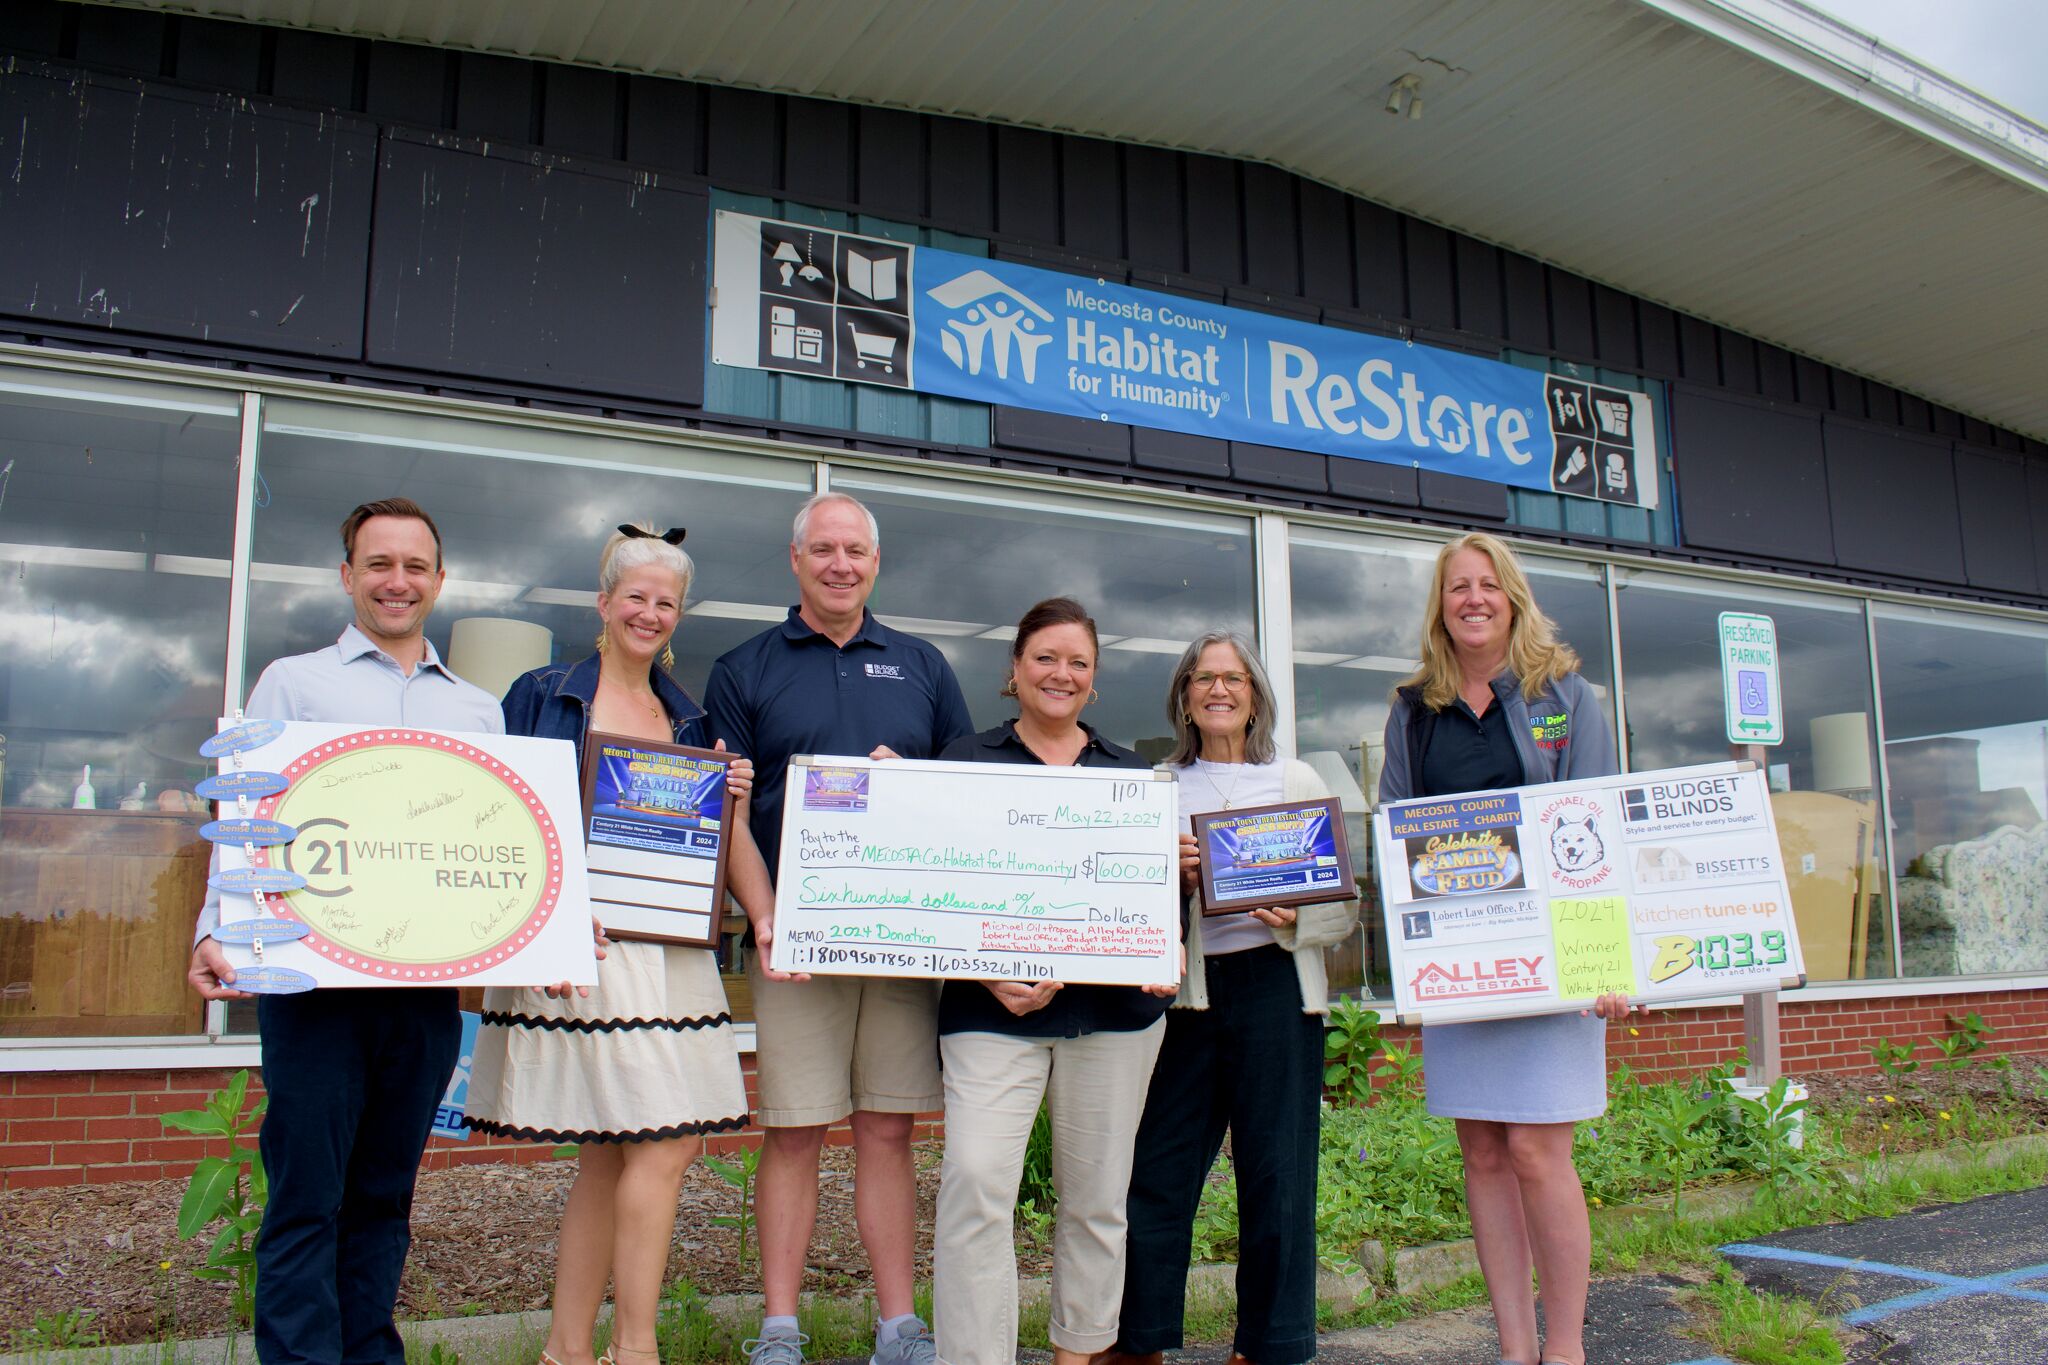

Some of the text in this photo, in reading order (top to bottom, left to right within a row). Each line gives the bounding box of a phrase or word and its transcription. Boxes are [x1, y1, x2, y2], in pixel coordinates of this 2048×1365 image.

[1066, 288, 1227, 339] Mecosta County
[1067, 317, 1220, 386] Habitat
[1068, 367, 1102, 394] for
[1725, 625, 1772, 645] RESERVED
[1730, 647, 1772, 666] PARKING
[1530, 716, 1545, 726] 07.1
[603, 747, 725, 773] MECOSTA COUNTY REAL ESTATE CHARITY
[216, 776, 270, 787] Chuck Ames
[628, 773, 697, 799] FAMILY
[1112, 782, 1146, 803] 1101
[1651, 776, 1739, 801] BUDGET
[1008, 808, 1048, 826] DATE
[1054, 805, 1090, 829] May
[1122, 812, 1161, 826] 2024
[1404, 798, 1506, 820] MECOSTA COUNTY
[1540, 796, 1605, 824] MICHAEL OIL
[1655, 796, 1734, 819] BLINDS
[219, 824, 279, 834] Denise Webb
[1208, 809, 1327, 830] MECOSTA COUNTY REAL ESTATE CHARITY
[1394, 823, 1421, 835] REAL
[1423, 818, 1460, 832] ESTATE
[1474, 811, 1521, 826] CHARITY
[1625, 827, 1645, 835] Style
[1647, 824, 1662, 833] and
[1663, 821, 1692, 831] service
[1692, 819, 1704, 828] for
[1705, 818, 1726, 827] every
[696, 837, 712, 845] 2024
[800, 828, 860, 849] Pay to the
[1425, 829, 1503, 855] Celebrity
[354, 841, 435, 861] WHITE
[443, 843, 527, 864] HOUSE
[1416, 845, 1512, 877] FAMILY
[800, 845, 839, 861] Order
[846, 845, 862, 859] of
[861, 845, 923, 863] MECOSTA
[943, 847, 986, 869] Habitat
[986, 849, 1003, 870] for
[1006, 851, 1073, 884] Humanity
[1695, 857, 1770, 874] BISSETT'S
[436, 869, 528, 890] REALTY
[1434, 870, 1505, 894] FEUD
[1551, 863, 1613, 889] & PROPANE
[921, 893, 977, 911] dollars
[981, 899, 1008, 912] and
[1559, 897, 1615, 923] 2024
[1634, 902, 1703, 924] kitchen
[1089, 907, 1149, 925] Dollars
[1409, 900, 1538, 936] L Lobert Law Office, P.C.
[788, 923, 937, 945] MEMO 2024 Donation
[982, 921, 1024, 932] Michael
[1026, 924, 1041, 932] Oil
[1087, 926, 1115, 938] Alley
[1117, 926, 1134, 935] Real
[1134, 927, 1166, 936] Estate
[1067, 935, 1099, 946] Budget
[1561, 940, 1620, 956] Winner
[1648, 929, 1788, 984] B103.9
[1411, 955, 1545, 986] ALLEY
[1562, 960, 1621, 978] Century 21
[1729, 967, 1745, 976] and
[1748, 966, 1772, 975] More
[1425, 977, 1543, 995] REAL ESTATE
[1566, 980, 1630, 996] White House
